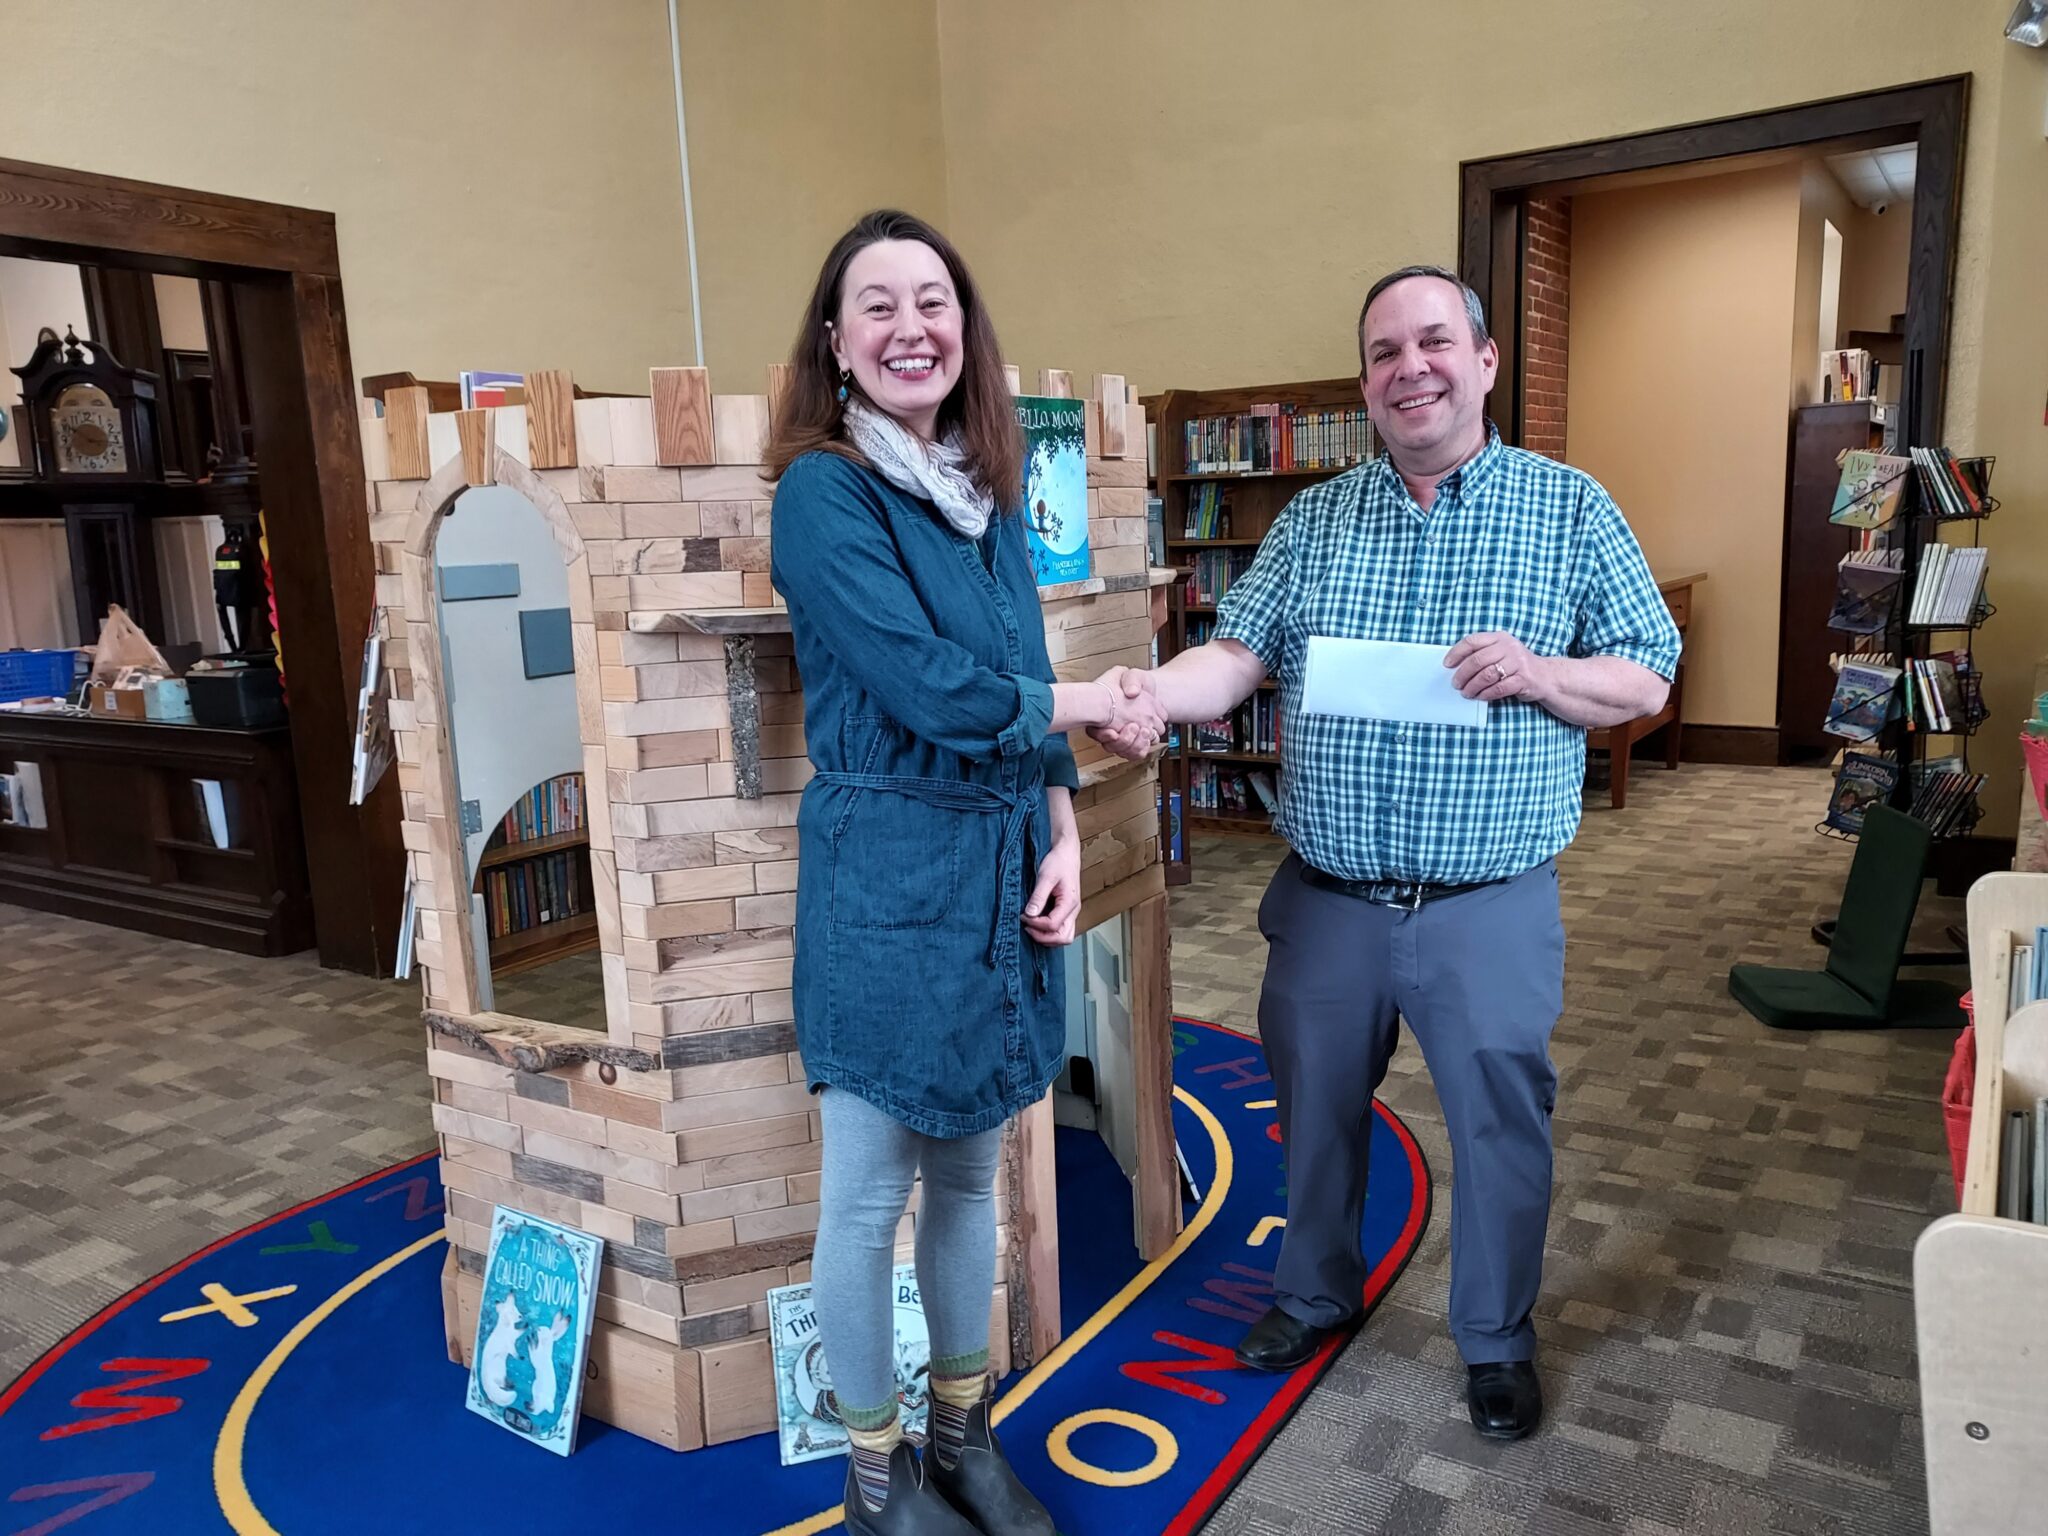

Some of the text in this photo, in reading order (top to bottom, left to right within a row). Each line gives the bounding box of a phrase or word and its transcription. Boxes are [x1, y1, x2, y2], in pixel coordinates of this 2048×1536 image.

[1051, 405, 1085, 432] MOON!
[259, 1221, 360, 1255] Y
[517, 1236, 561, 1272] A THING
[159, 1282, 299, 1328] X
[495, 1256, 577, 1310] CALLED SNOW
[39, 1357, 212, 1442] W
[1046, 1408, 1179, 1488] O
